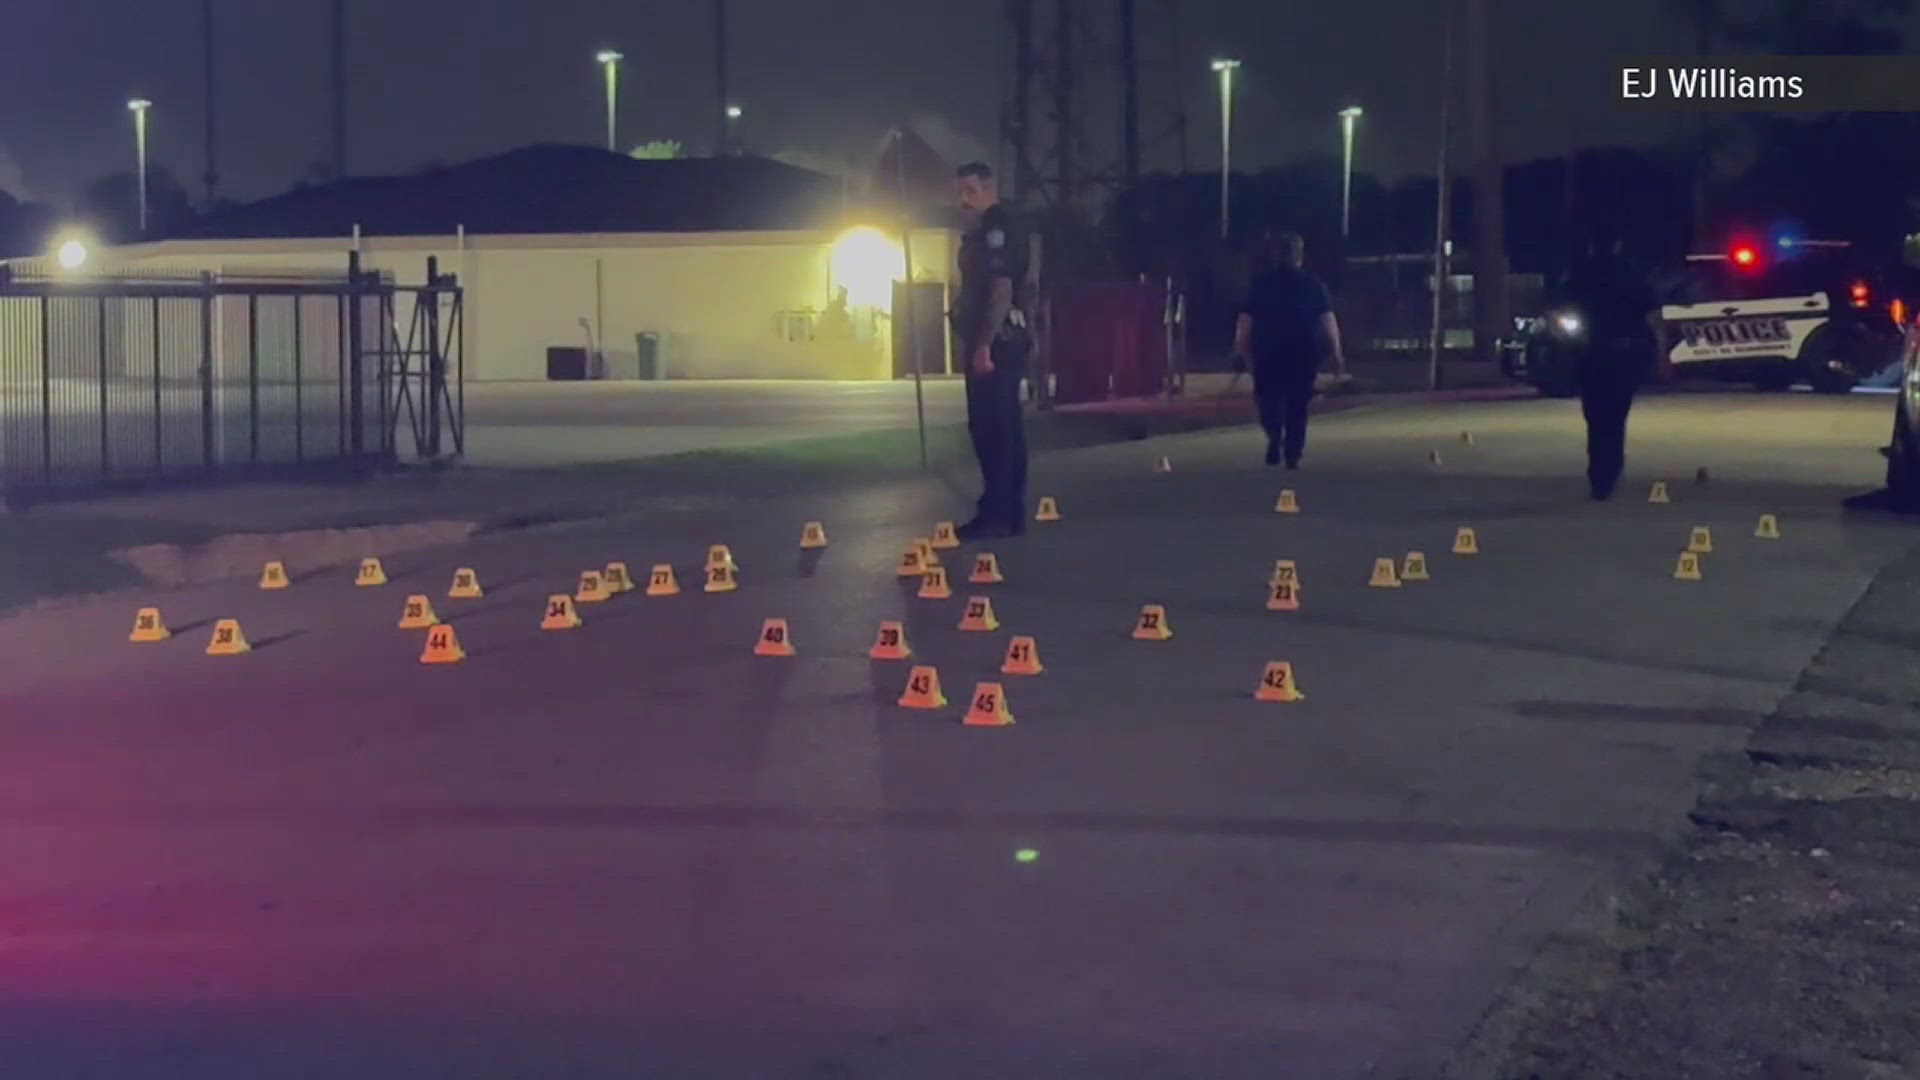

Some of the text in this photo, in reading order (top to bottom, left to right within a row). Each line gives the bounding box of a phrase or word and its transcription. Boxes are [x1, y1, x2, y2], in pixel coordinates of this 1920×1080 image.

[1682, 317, 1792, 347] POLICE
[362, 564, 376, 577] 17
[977, 559, 991, 573] 24
[654, 571, 669, 585] 27
[926, 573, 940, 587] 31
[549, 602, 565, 617] 34
[968, 602, 985, 618] 33
[1141, 613, 1159, 629] 32
[429, 633, 447, 649] 44
[764, 627, 783, 643] 40
[1009, 645, 1029, 662] 41
[910, 676, 929, 695] 43
[1264, 669, 1286, 688] 42
[975, 694, 995, 713] 45
